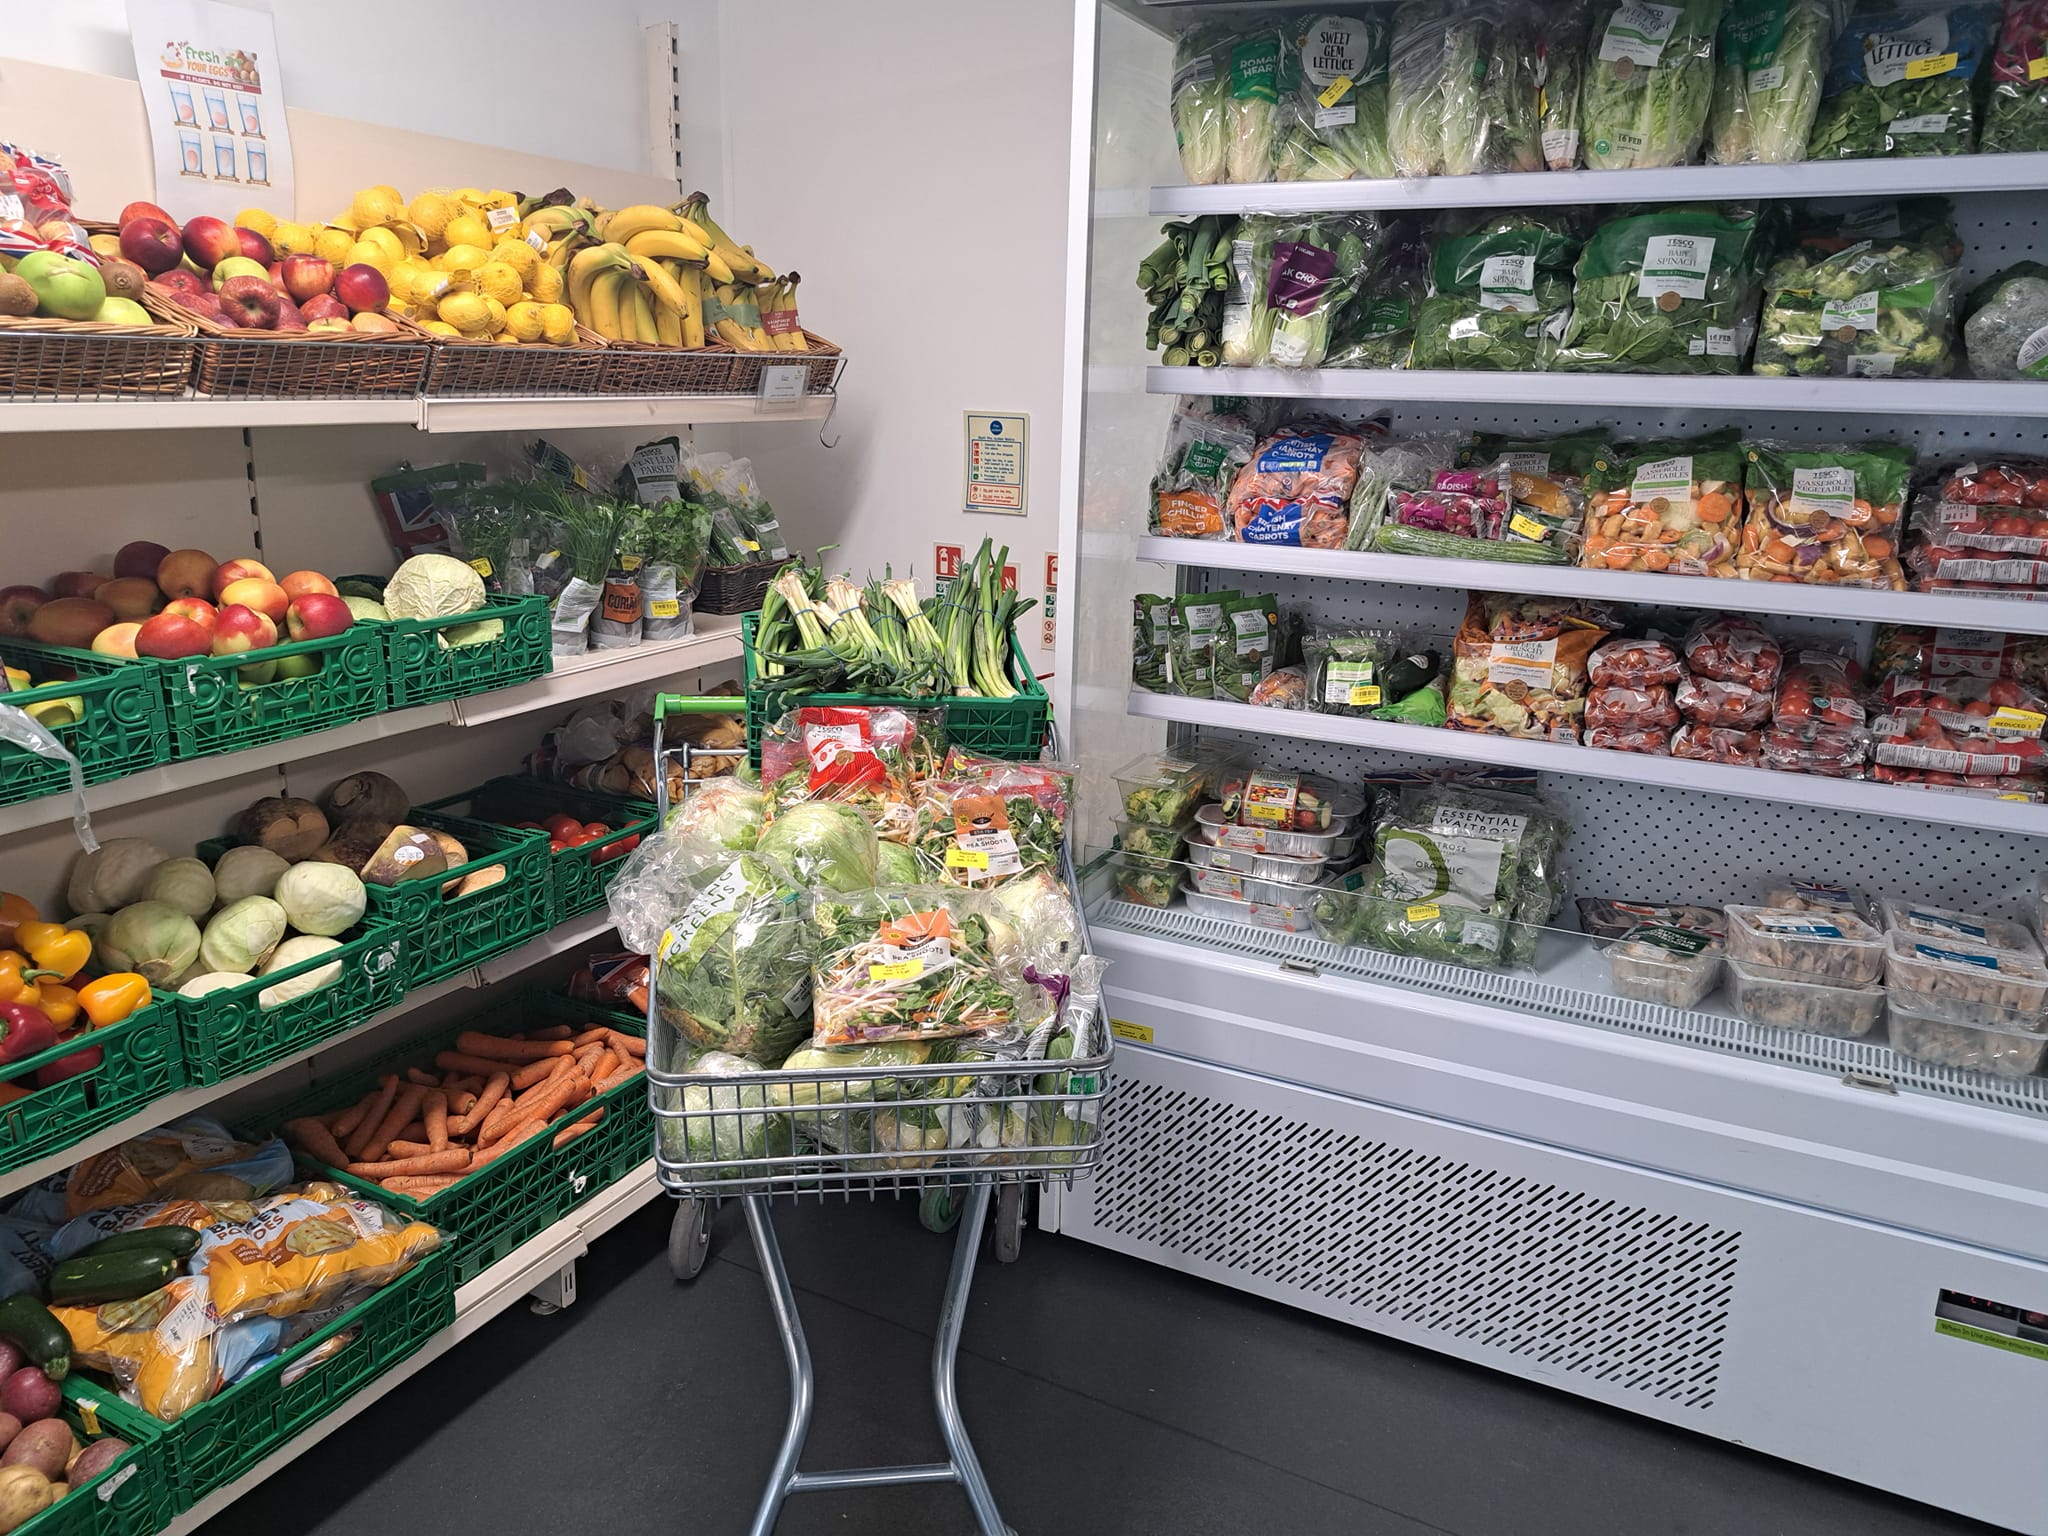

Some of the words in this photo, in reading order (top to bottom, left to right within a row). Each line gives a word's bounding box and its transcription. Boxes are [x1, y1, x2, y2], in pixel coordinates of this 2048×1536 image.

[1320, 31, 1351, 45] SWEET
[185, 46, 220, 64] fresh
[1323, 45, 1345, 58] GEM
[1871, 44, 1935, 65] LETTUCE
[1240, 55, 1277, 70] ROMAI
[1313, 56, 1355, 71] LETTUCE
[186, 61, 207, 73] YOUR
[208, 64, 229, 77] EGGS
[1243, 65, 1277, 79] HEAR
[1628, 136, 1642, 146] FEB
[1668, 238, 1695, 247] TESCO
[1668, 249, 1689, 258] BABY
[1501, 259, 1525, 267] TESCO
[1656, 257, 1697, 267] SPINACH
[1492, 276, 1526, 287] SPINACH
[640, 464, 675, 475] PARSLEY
[1812, 470, 1840, 479] TESCO
[1436, 482, 1469, 491] RADISH
[1797, 479, 1850, 487] CASSEROLE
[1796, 485, 1854, 493] VEGETABLES
[1171, 499, 1208, 514] FINGER
[1248, 531, 1289, 541] CARROTS
[1504, 644, 1545, 656] CRUNCHY
[1511, 652, 1535, 660] SALAD
[1995, 721, 2025, 729] REDUCED
[1441, 809, 1520, 828] ESSENTIAL
[980, 838, 1008, 848] SHOOTS
[1418, 838, 1467, 853] WAITROSE
[1415, 860, 1464, 876] ORGANIC
[669, 884, 736, 956] GREENS
[911, 946, 944, 958] SHOOTS
